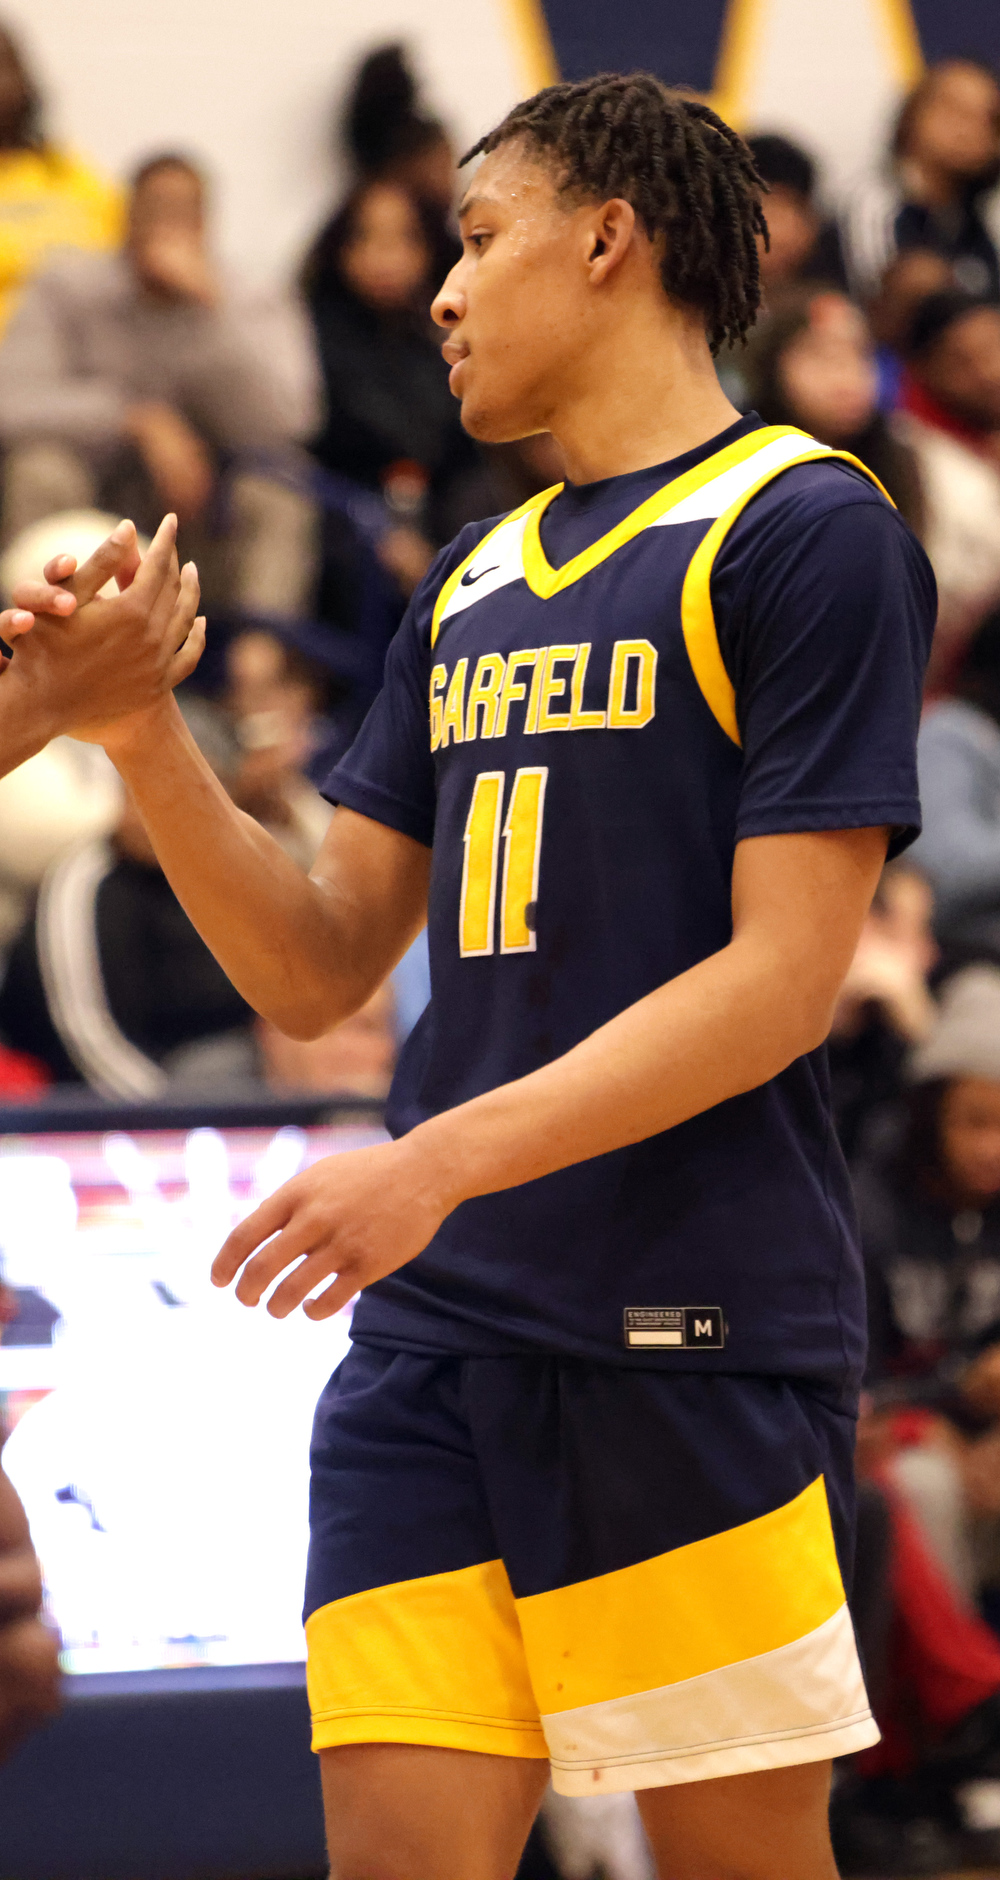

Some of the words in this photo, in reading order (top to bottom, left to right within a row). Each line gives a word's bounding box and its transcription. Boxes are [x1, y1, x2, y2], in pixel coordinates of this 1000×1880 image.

[429, 639, 659, 753] GARFIELD
[458, 766, 549, 959] 11
[694, 1319, 712, 1337] M
